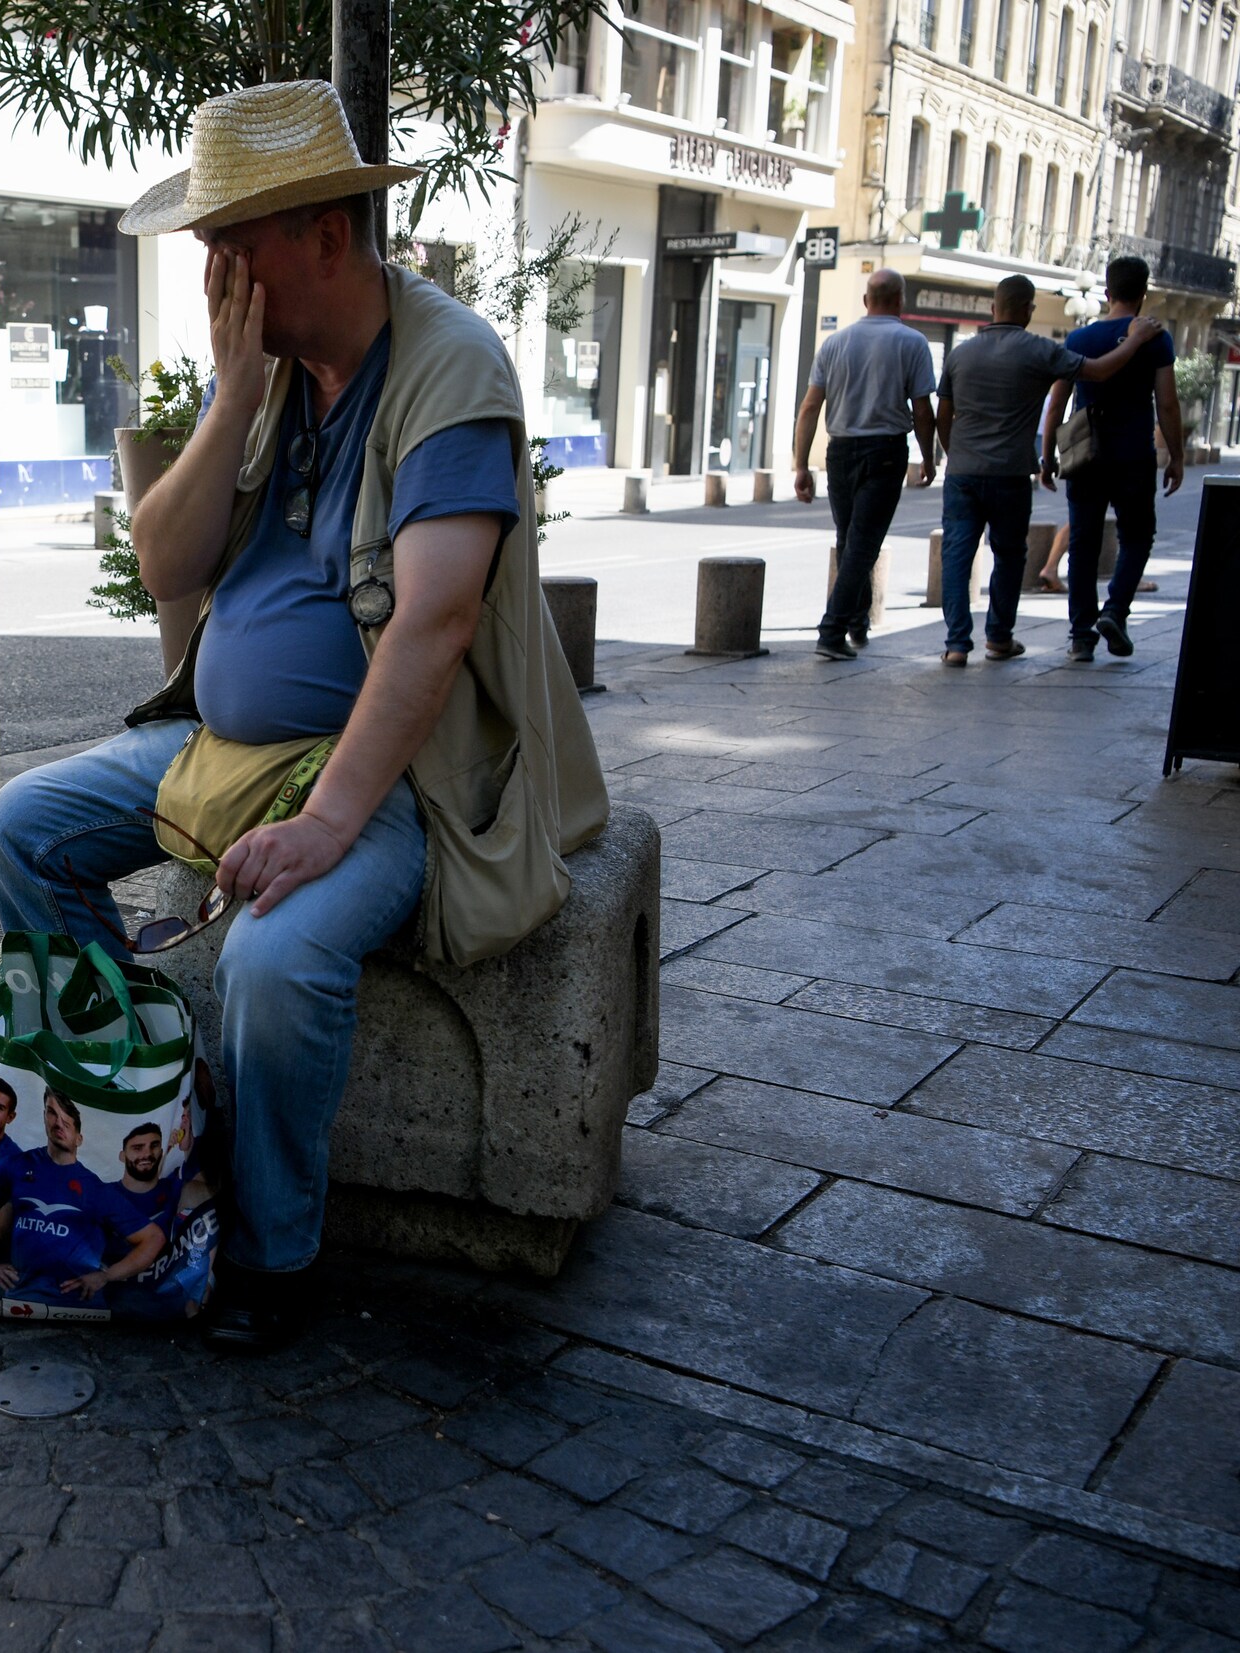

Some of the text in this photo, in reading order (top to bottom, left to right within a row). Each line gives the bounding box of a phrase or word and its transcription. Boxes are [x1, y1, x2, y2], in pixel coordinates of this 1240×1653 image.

[666, 236, 732, 249] RESTAURANT
[15, 1216, 69, 1237] ALTRAD
[137, 1207, 219, 1282] FRANCE
[52, 1311, 106, 1319] Casino
